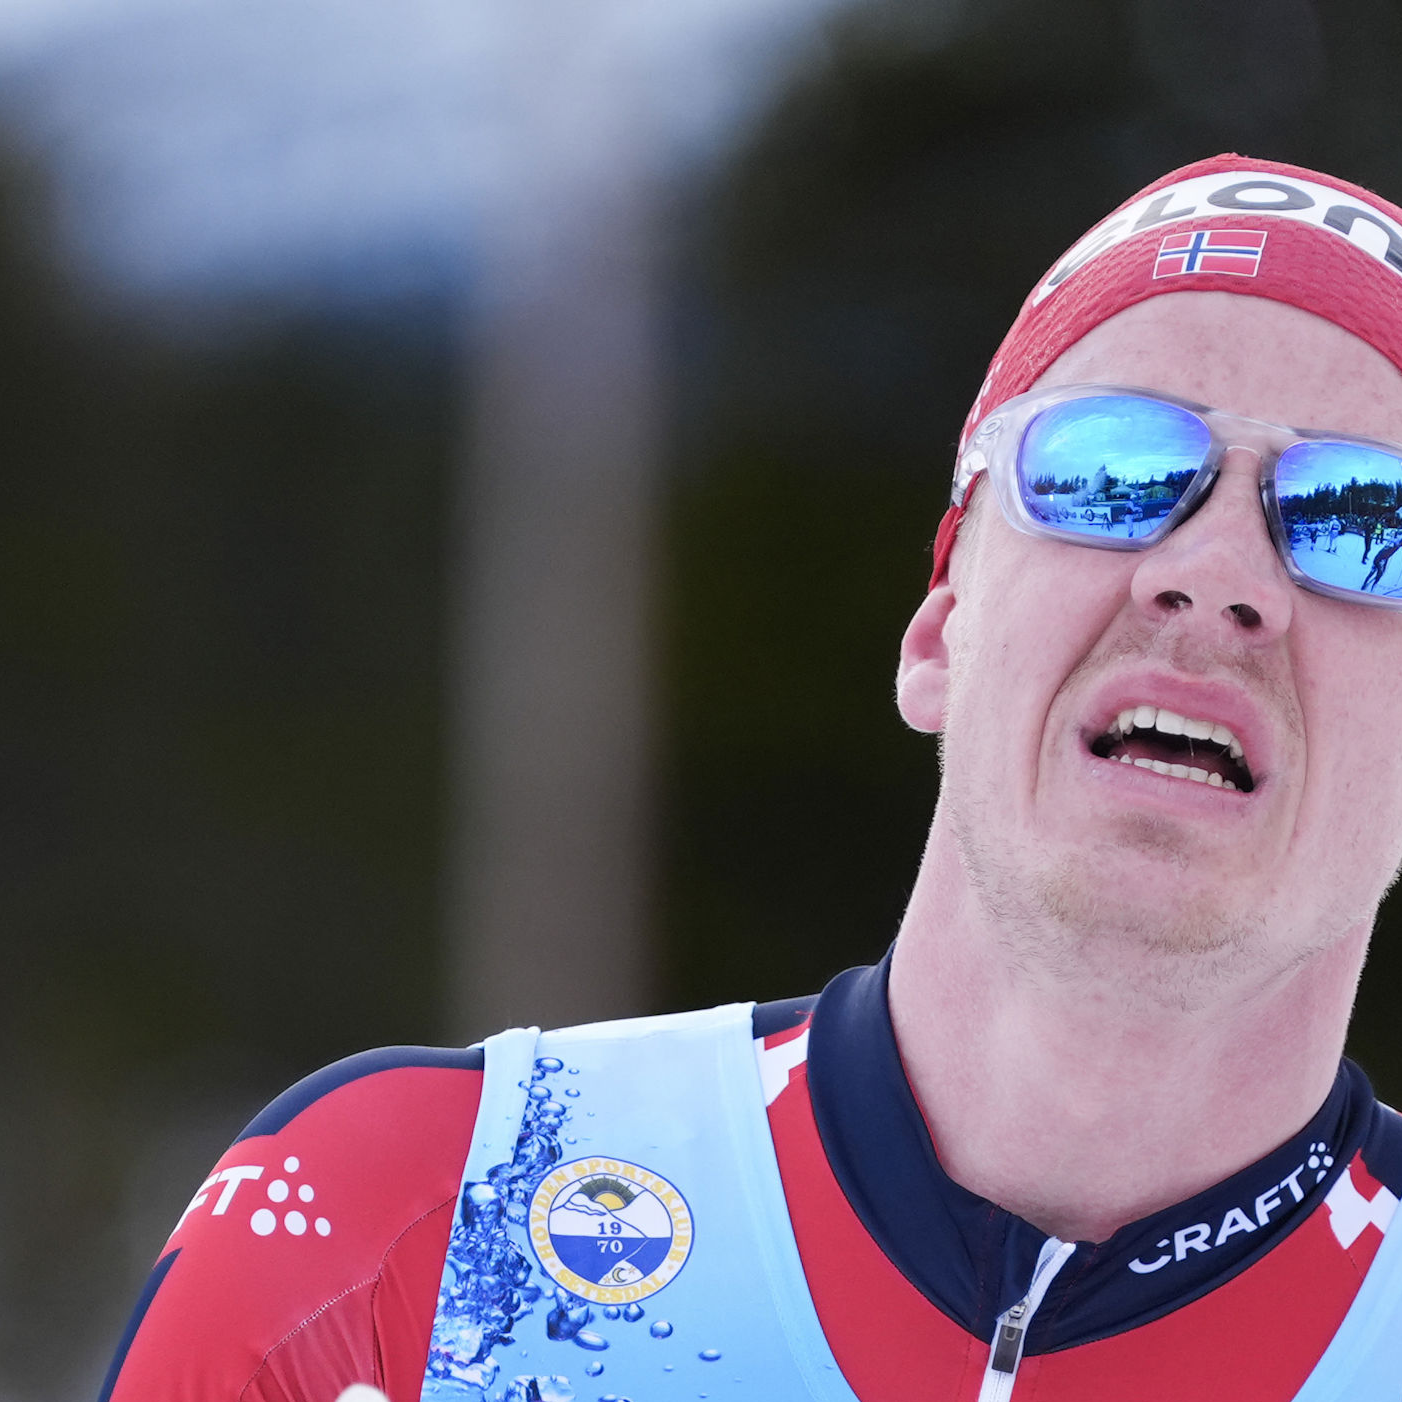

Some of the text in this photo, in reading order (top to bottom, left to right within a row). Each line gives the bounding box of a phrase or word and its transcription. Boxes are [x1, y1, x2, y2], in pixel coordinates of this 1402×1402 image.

[532, 1170, 569, 1261] HOVDEN
[597, 1221, 622, 1236] 19
[1128, 1163, 1305, 1274] CRAFT
[597, 1240, 623, 1254] 70
[555, 1268, 666, 1303] SETESDAL
